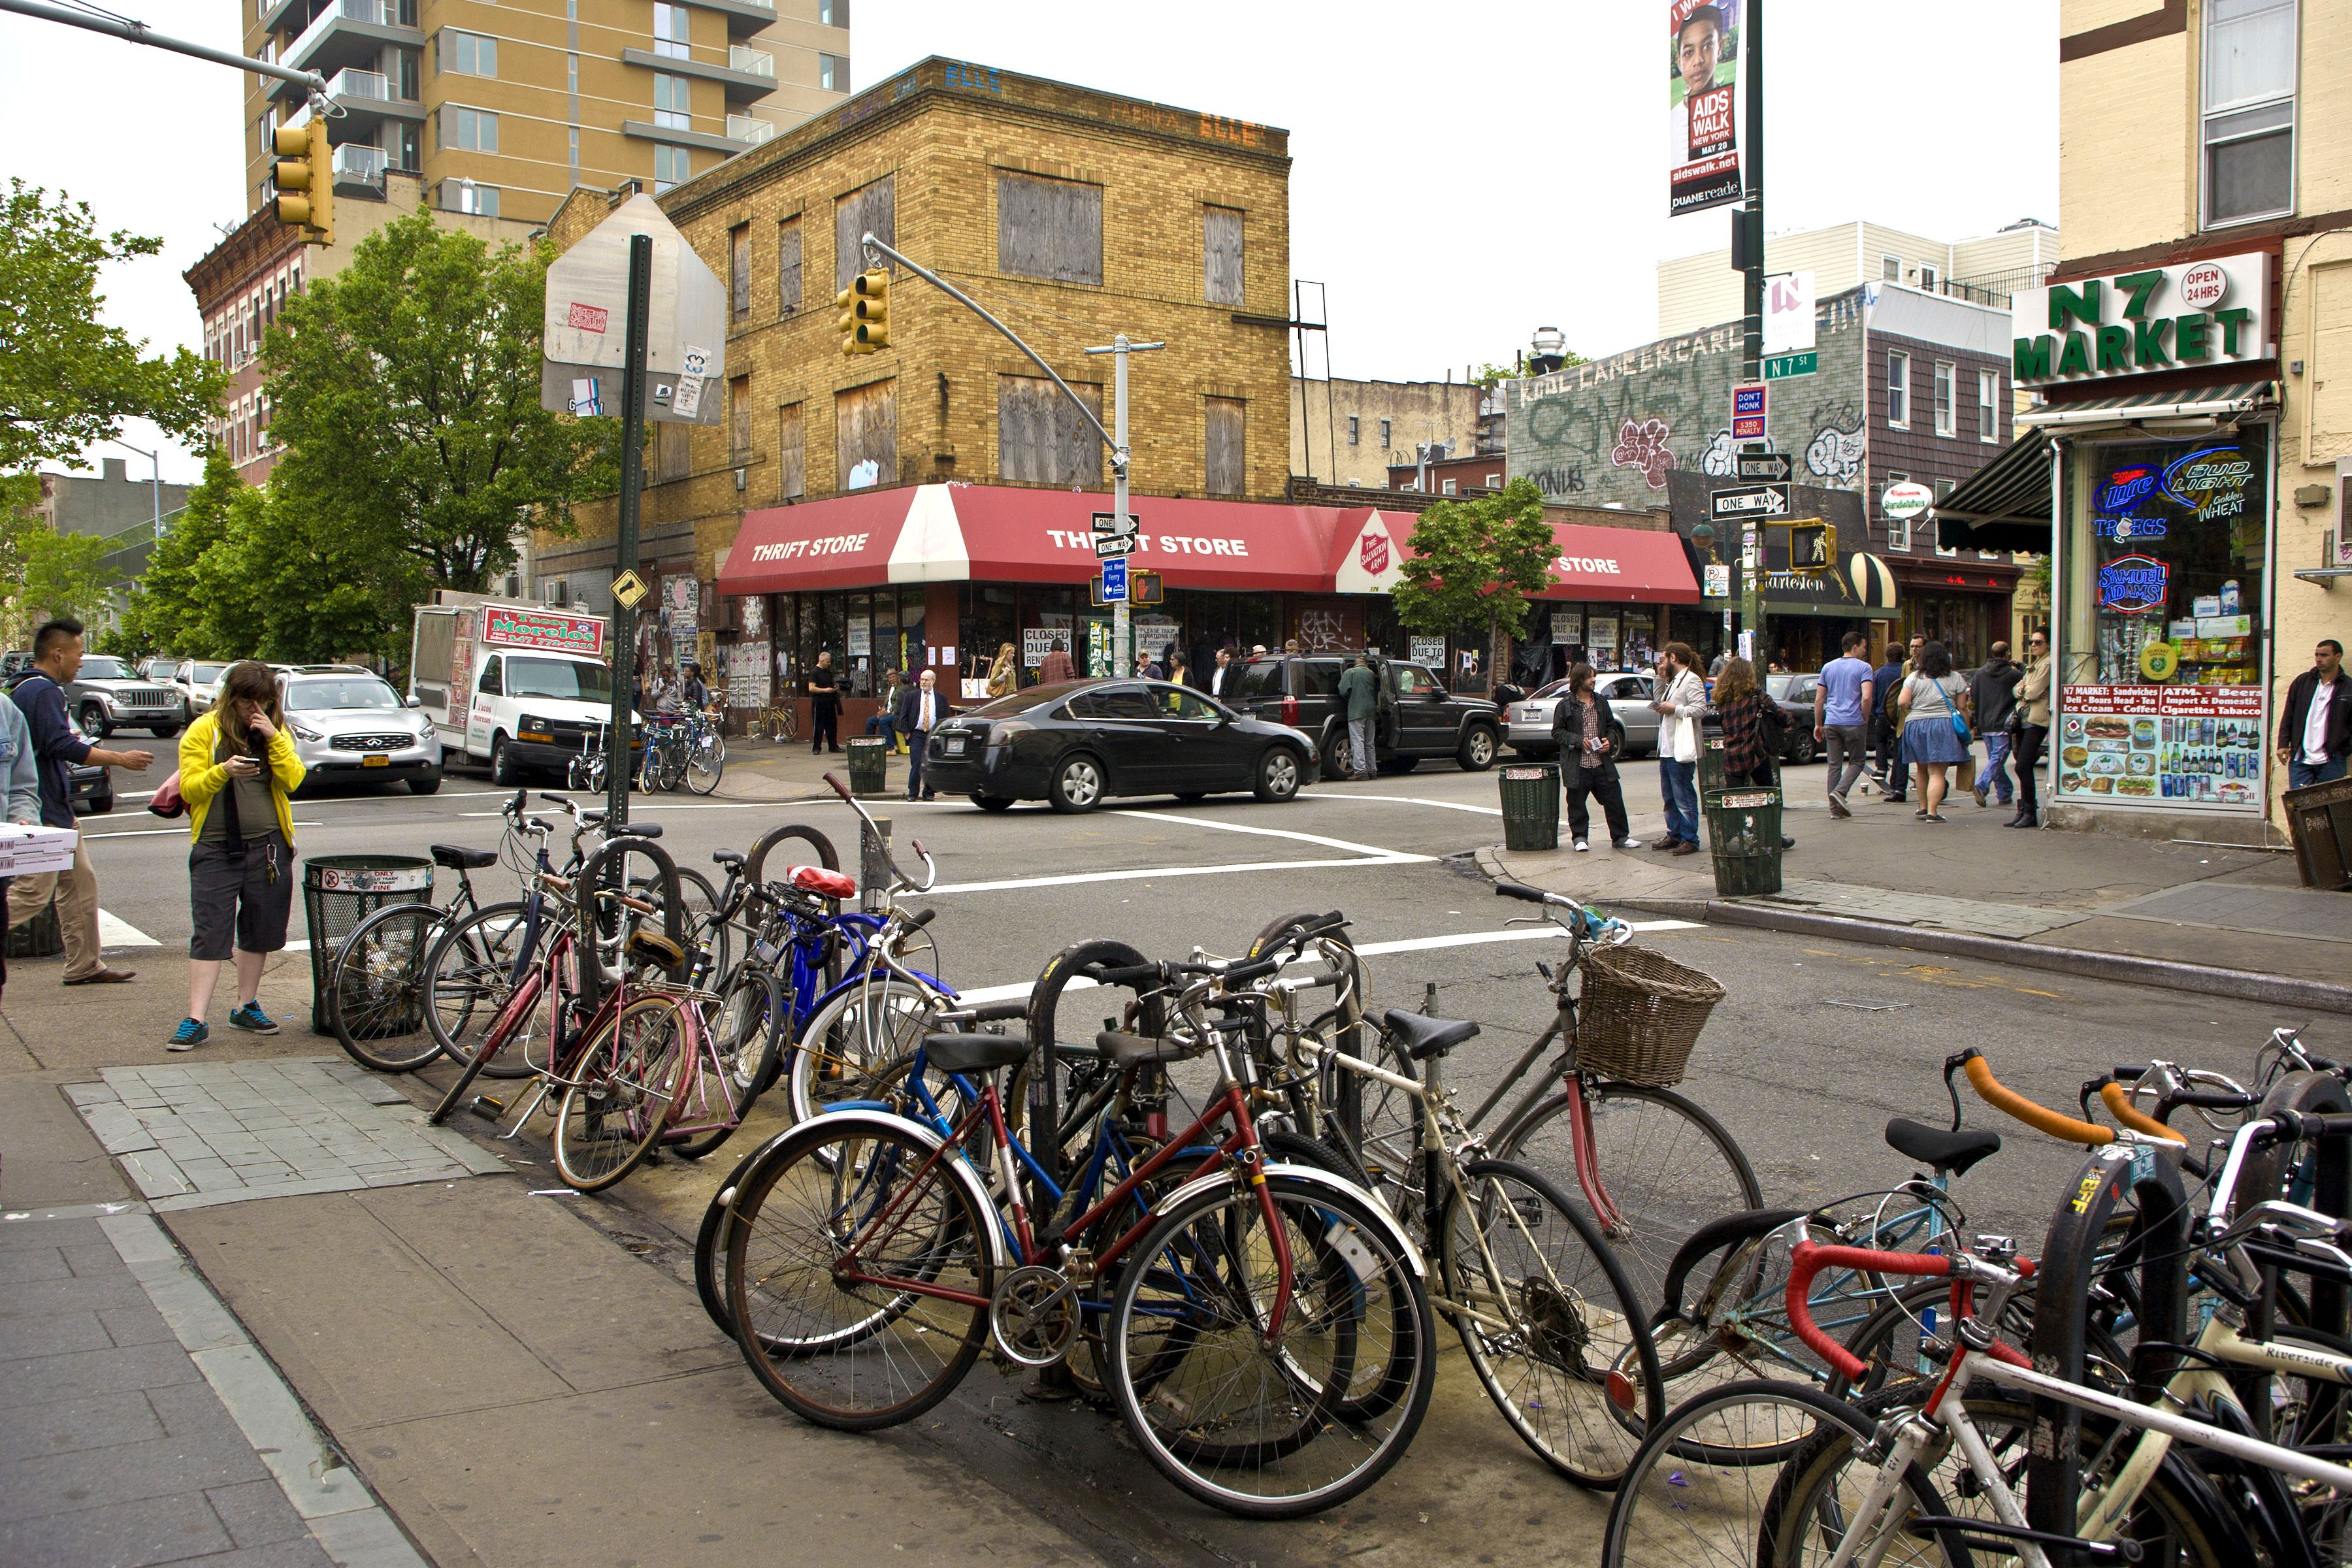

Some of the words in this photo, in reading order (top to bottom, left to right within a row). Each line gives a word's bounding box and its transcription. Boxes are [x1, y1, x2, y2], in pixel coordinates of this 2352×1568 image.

[945, 61, 1002, 92] ELLE
[1693, 90, 1729, 120] AIDS
[1693, 112, 1729, 137] WALK
[1693, 135, 1709, 146] NEW
[1710, 129, 1729, 142] YORK
[1701, 145, 1716, 155] MAY
[1718, 142, 1727, 151] 20
[1673, 156, 1736, 181] aidswalk.net
[2187, 269, 2219, 284] OPEN
[2049, 280, 2100, 329] N
[2114, 270, 2164, 319] 7
[2187, 287, 2199, 301] 24
[2200, 285, 2219, 299] HRS
[2014, 308, 2249, 381] MARKET
[1772, 360, 1780, 377] N
[1787, 358, 1794, 375] 7
[1799, 355, 1808, 366] St
[1738, 392, 1761, 402] DON'T
[1739, 401, 1760, 411] HONK
[1736, 427, 1761, 436] PENALTY
[1745, 461, 1760, 474] ONE
[1767, 461, 1784, 474] WAY
[2186, 461, 2250, 478] BUD
[2171, 474, 2255, 492] LIGHT
[1722, 498, 1744, 510] ONE
[1754, 493, 1777, 507] WAY
[2213, 493, 2244, 505] Golden
[2198, 499, 2246, 522] WHEAT
[1099, 518, 1113, 527] ONE
[752, 540, 810, 562] THRIFT
[809, 533, 870, 556] STORE
[1046, 530, 1150, 551] THRT
[1160, 536, 1249, 556] STORE
[1101, 543, 1113, 552] ONE
[1118, 538, 1130, 549] WAY
[1365, 537, 1377, 551] THE
[1362, 540, 1387, 566] SALVATION
[1370, 553, 1386, 571] ARMY
[1558, 556, 1621, 574] STORE
[2099, 566, 2166, 587] SAMUEL
[2101, 585, 2163, 605] ADAMS
[517, 614, 569, 627] Tacos
[492, 619, 595, 642] Morelos
[1026, 630, 1068, 640] CLOSED
[508, 635, 533, 644] 347
[536, 638, 595, 649] 772-5216
[1026, 643, 1050, 653] DUE
[1411, 637, 1443, 645] CLOSED
[1412, 648, 1429, 657] DUE
[1433, 648, 1443, 657] TO
[2063, 687, 2072, 695] N7
[2076, 687, 2110, 695] MARKET:
[2113, 687, 2158, 696] Sandwiches
[2123, 705, 2157, 713] Coffee
[2161, 706, 2215, 715] Cigarettes
[2217, 706, 2261, 715] Tabacco
[2072, 1179, 2101, 1214] BFF
[2266, 1347, 2333, 1367] Riverside
